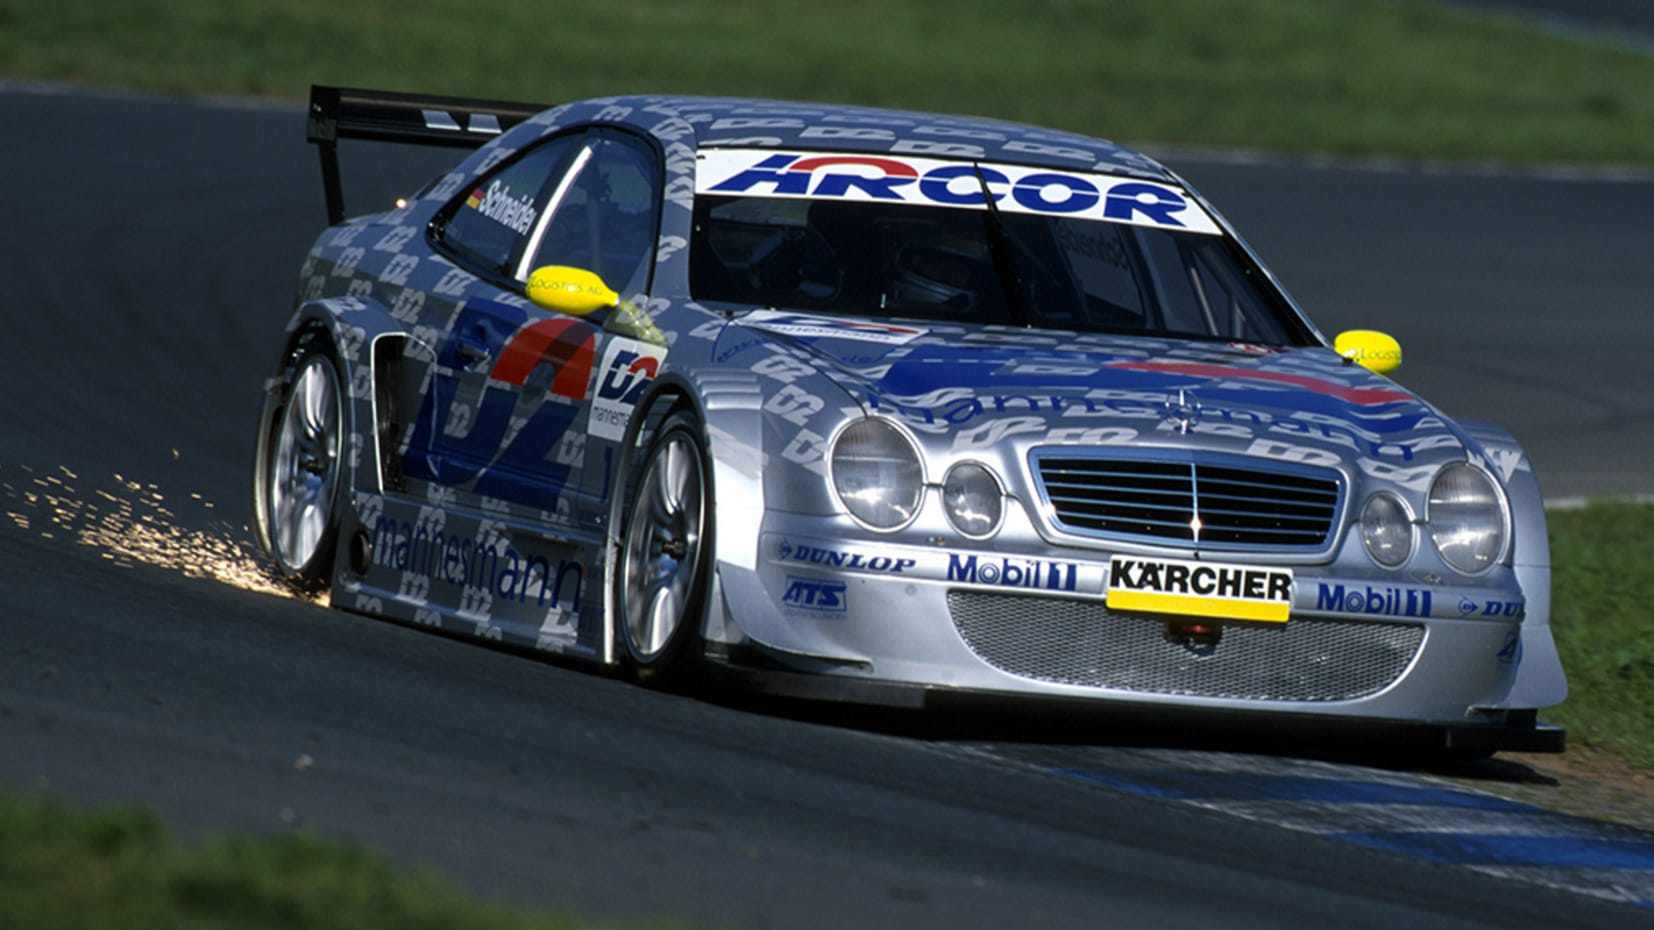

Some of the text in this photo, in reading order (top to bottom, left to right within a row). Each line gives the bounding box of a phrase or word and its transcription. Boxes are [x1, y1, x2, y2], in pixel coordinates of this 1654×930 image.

[478, 179, 537, 236] Schneider
[706, 154, 1188, 228] ARCOR
[598, 349, 660, 404] D2
[402, 298, 596, 512] D2
[371, 514, 585, 612] mannesmann
[793, 545, 917, 573] DUNLOP
[947, 553, 1077, 592] Mobil 1
[1110, 559, 1292, 601] KÄRCHER
[782, 580, 848, 607] ATS
[1317, 583, 1432, 618] Mobil 1
